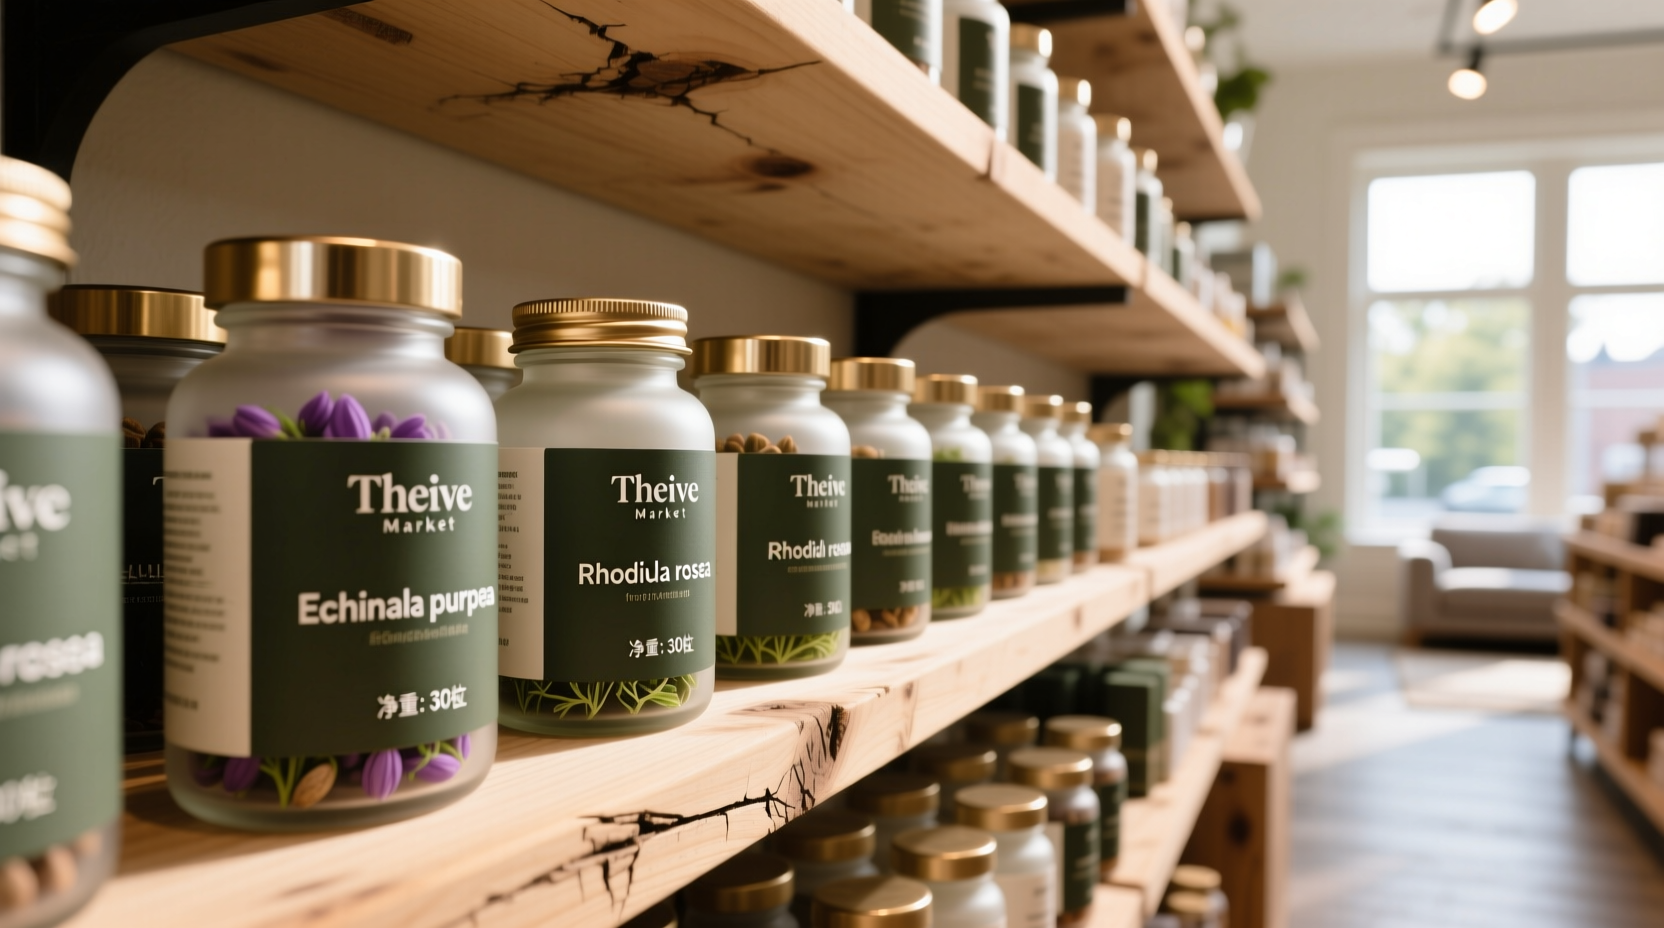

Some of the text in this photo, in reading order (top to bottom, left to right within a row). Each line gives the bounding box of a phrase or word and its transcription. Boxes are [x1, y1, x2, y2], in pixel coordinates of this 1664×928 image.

[347, 472, 472, 514] Theive
[611, 473, 699, 503] Theive
[383, 516, 455, 534] Market
[635, 507, 686, 519] Market
[298, 586, 495, 625] Echinala purpea
